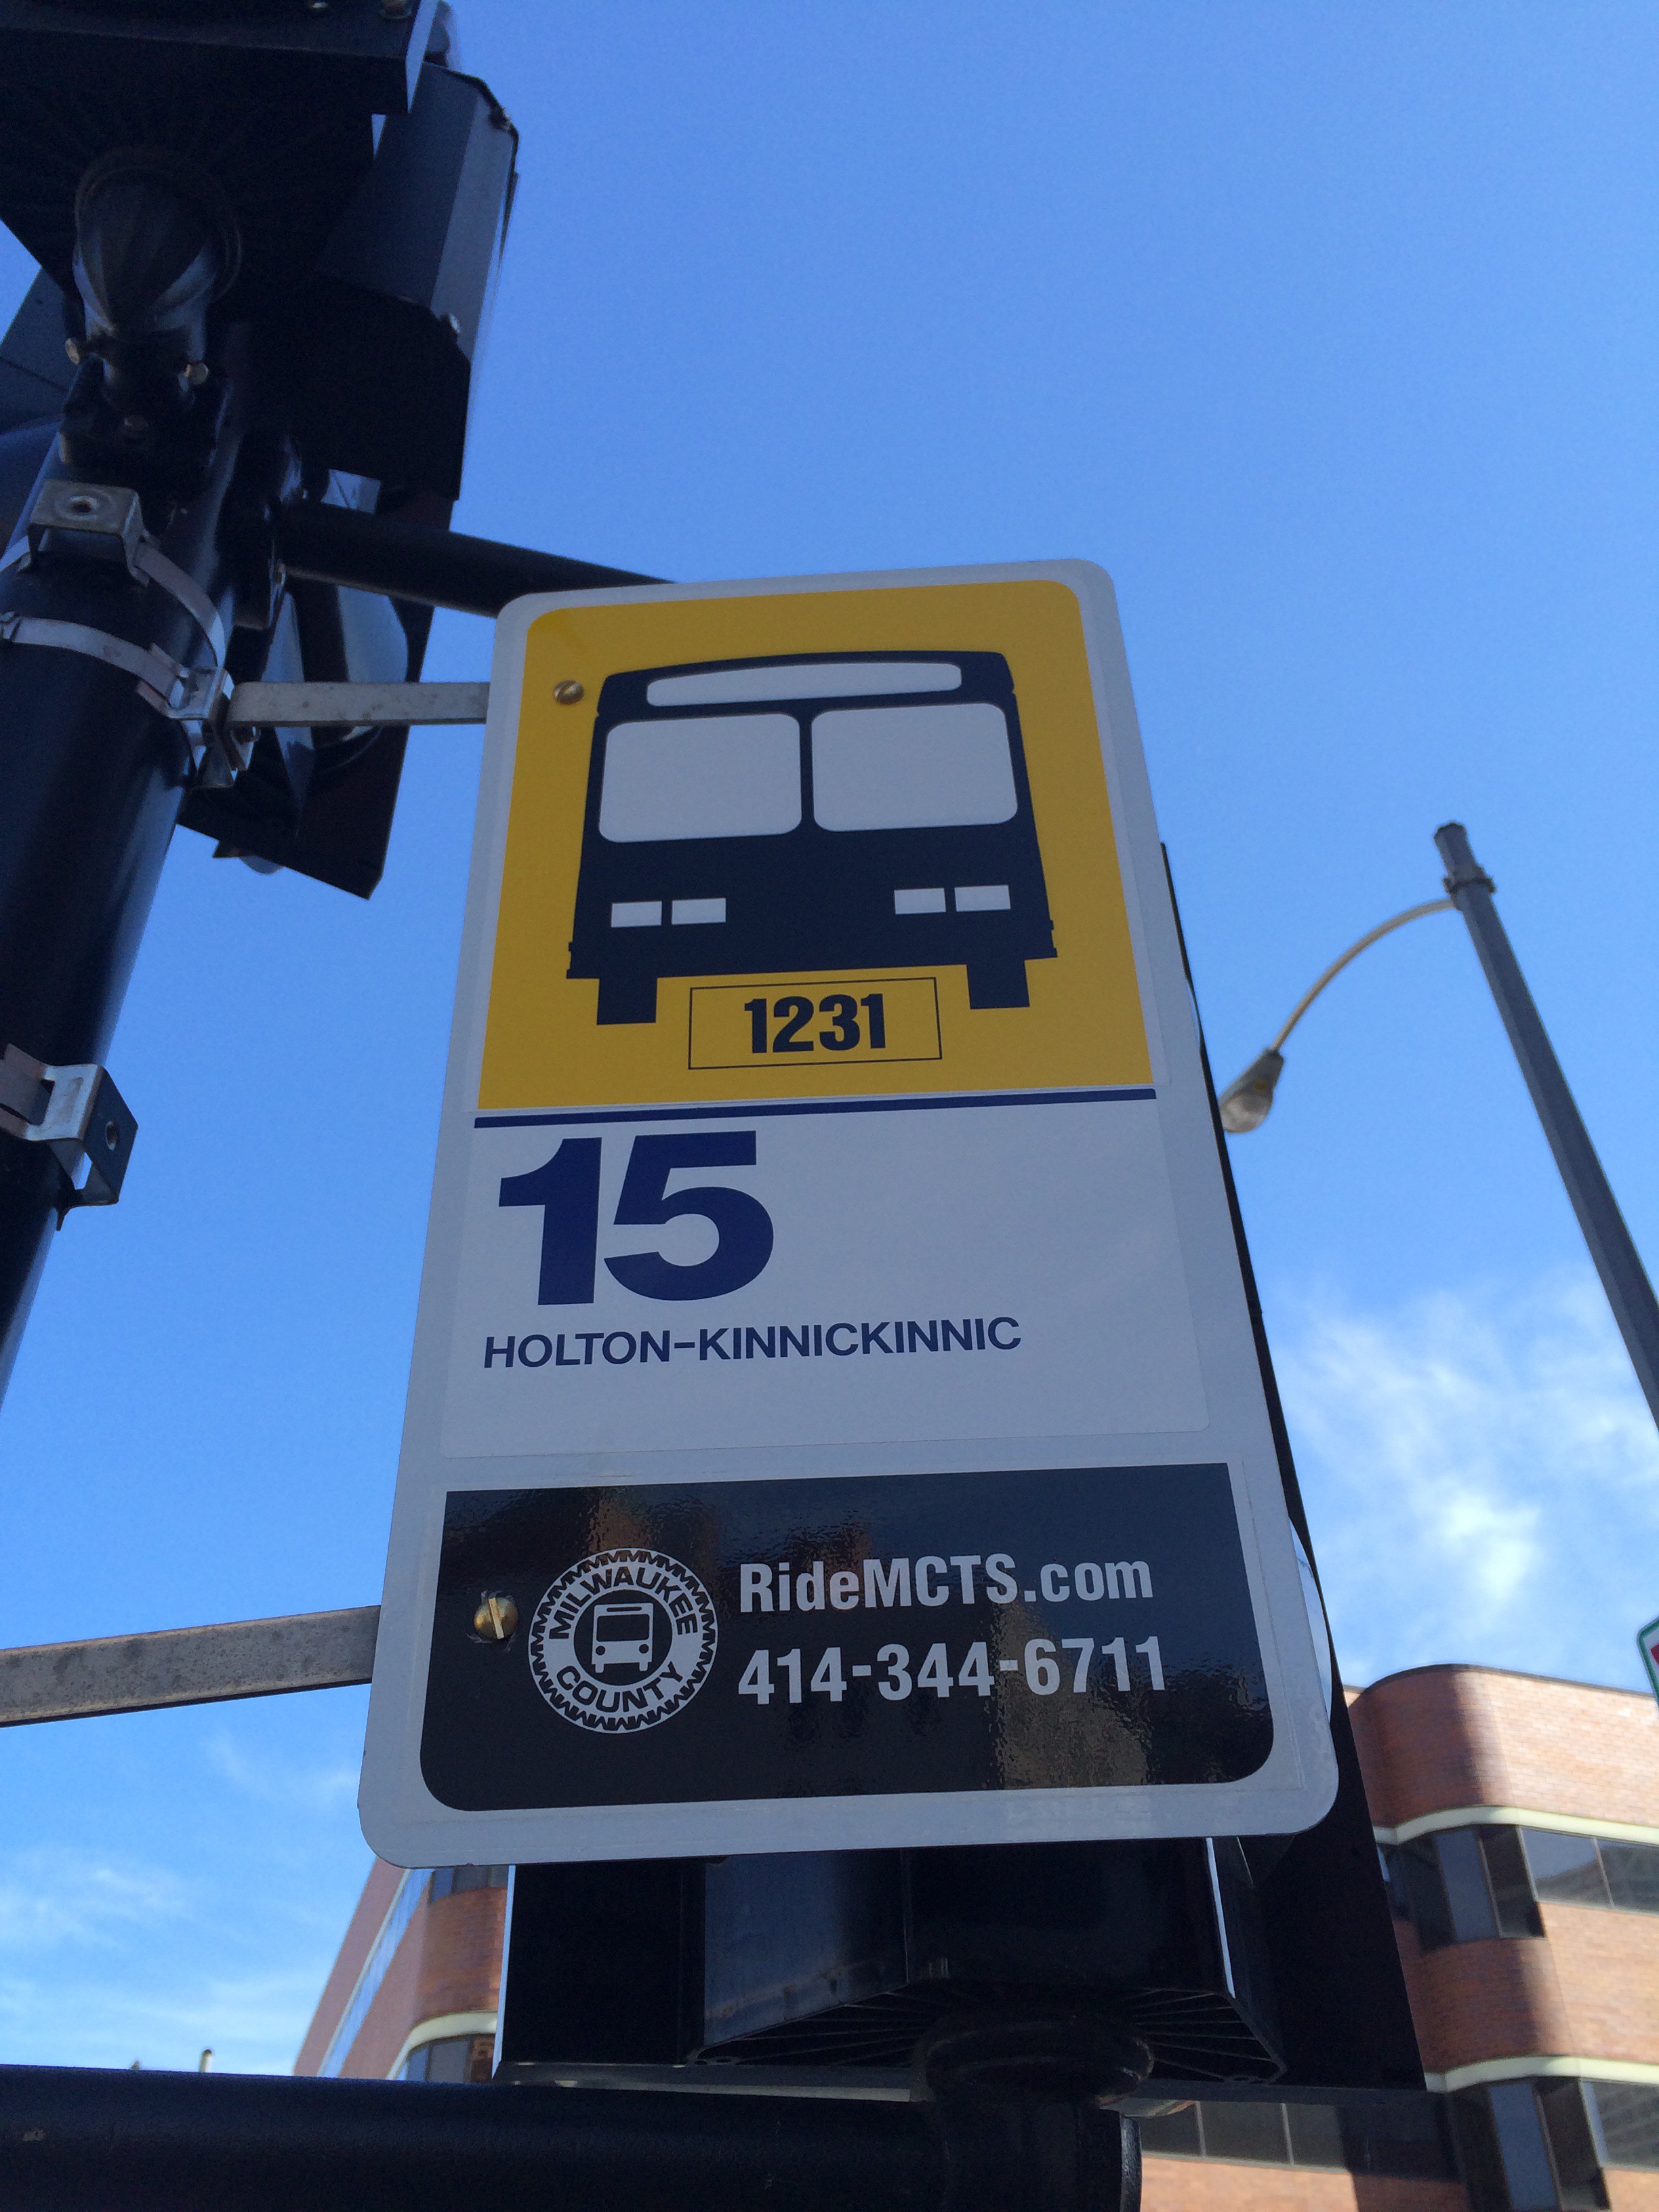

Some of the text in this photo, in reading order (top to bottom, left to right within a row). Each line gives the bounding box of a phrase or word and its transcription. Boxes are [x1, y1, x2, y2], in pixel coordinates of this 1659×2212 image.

[743, 993, 886, 1054] 1231
[498, 1130, 774, 1306] 15
[483, 1316, 1022, 1369] HOLTON-KINNICKINNIC
[548, 1565, 699, 1639] MILWAUKEE
[739, 1553, 1153, 1613] RideMCTS.com
[556, 1660, 684, 1713] COUNTY
[738, 1635, 1166, 1705] 414-344-6711
